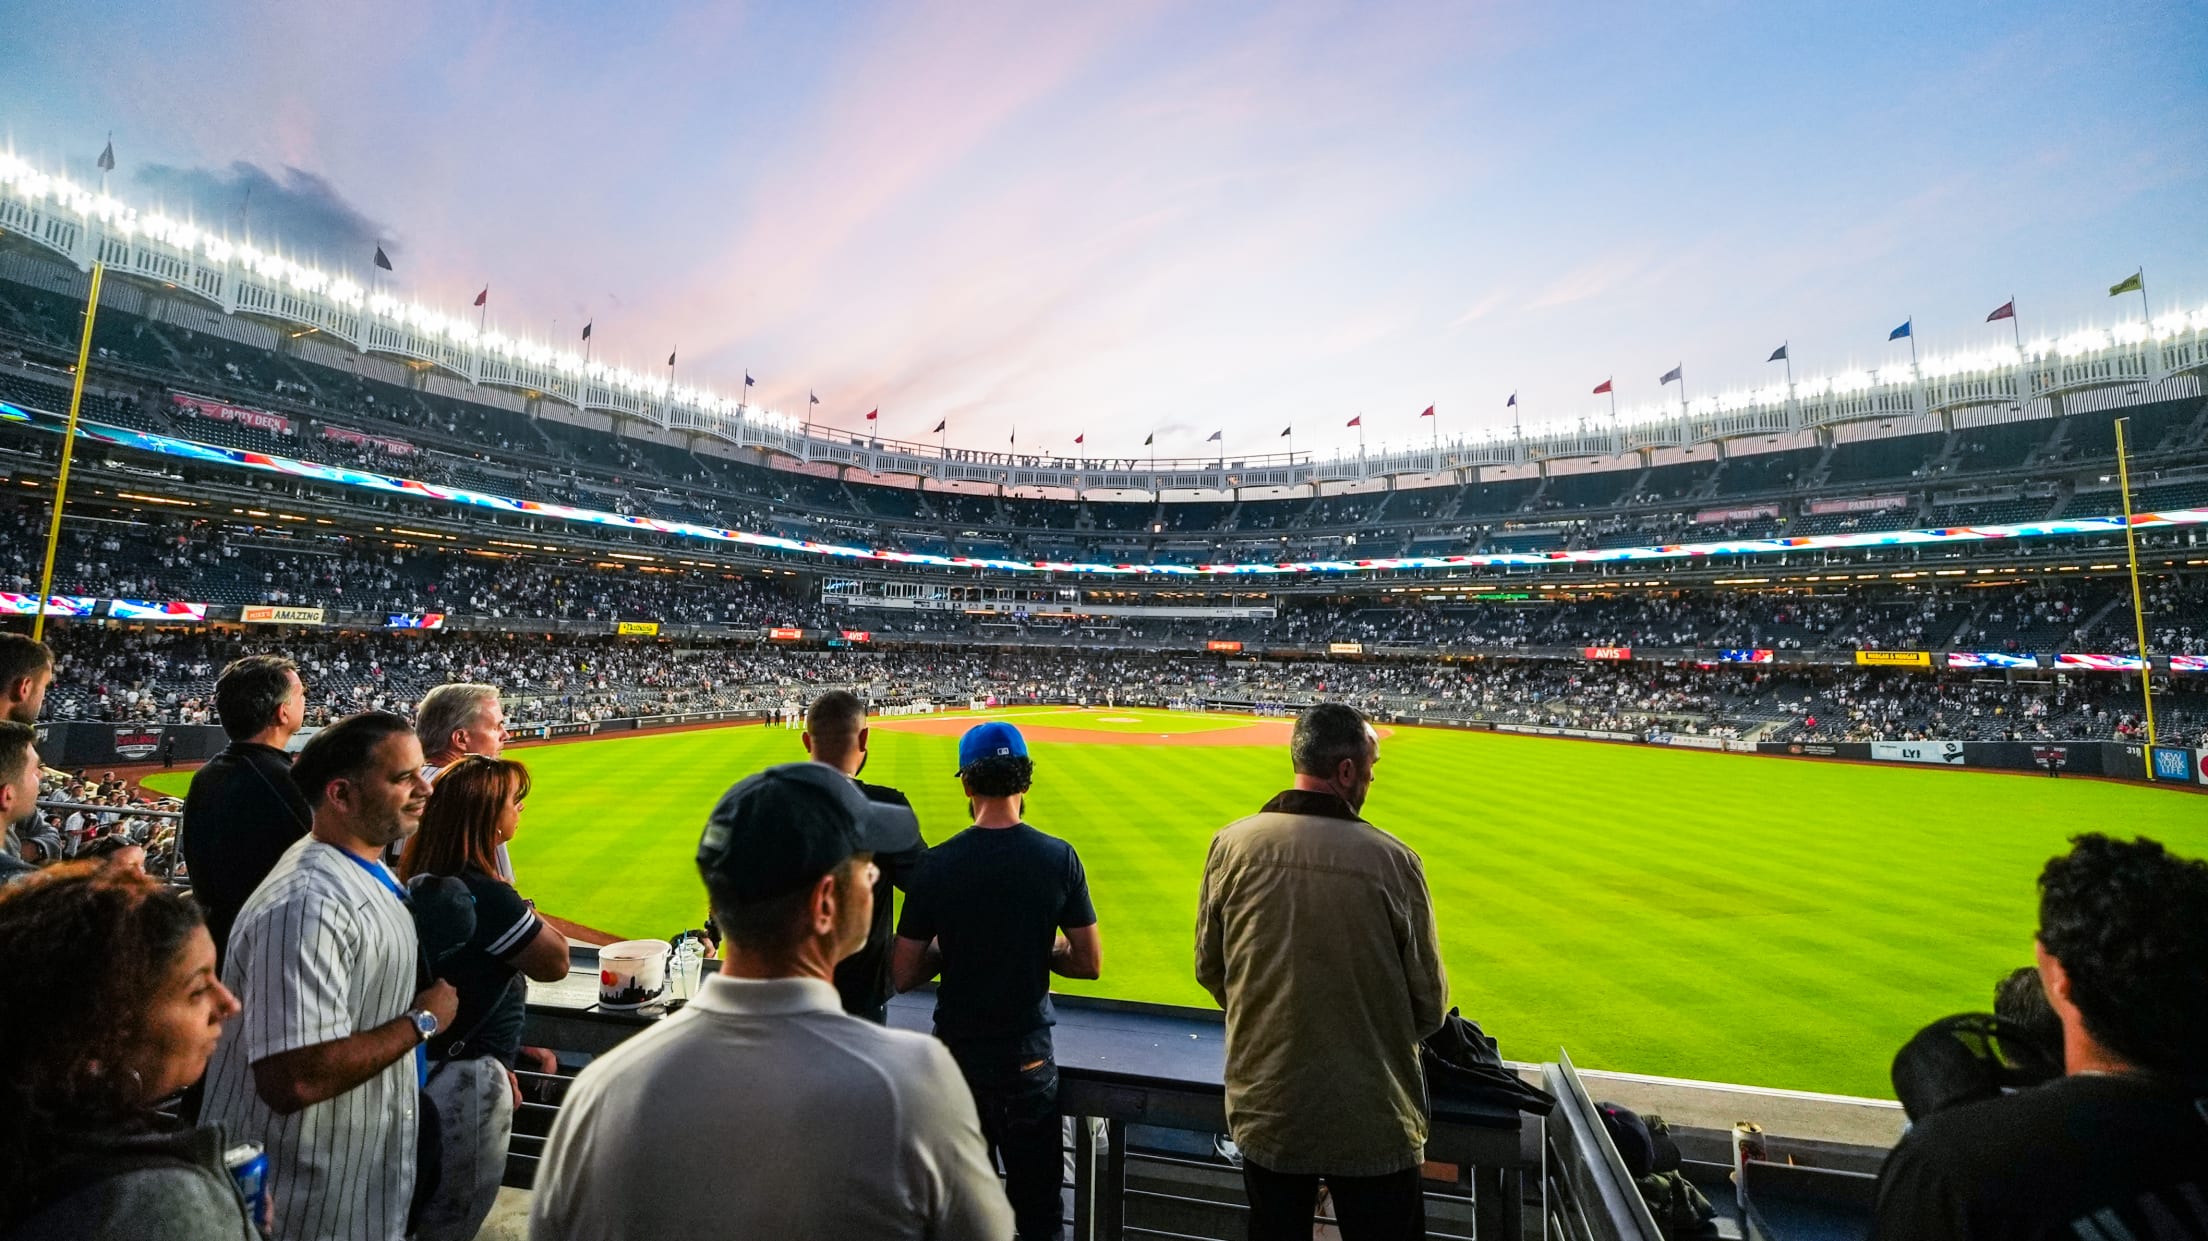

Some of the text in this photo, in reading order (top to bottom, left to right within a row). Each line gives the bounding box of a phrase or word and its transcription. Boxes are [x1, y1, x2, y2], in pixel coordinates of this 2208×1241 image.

[221, 407, 280, 430] PARTY DECK
[273, 610, 320, 621] AMAZING
[847, 631, 863, 640] AVIS
[1595, 649, 1620, 658] AVIS
[2160, 752, 2182, 761] NEW
[2158, 758, 2185, 769] YORK
[2161, 765, 2183, 775] LIFE
